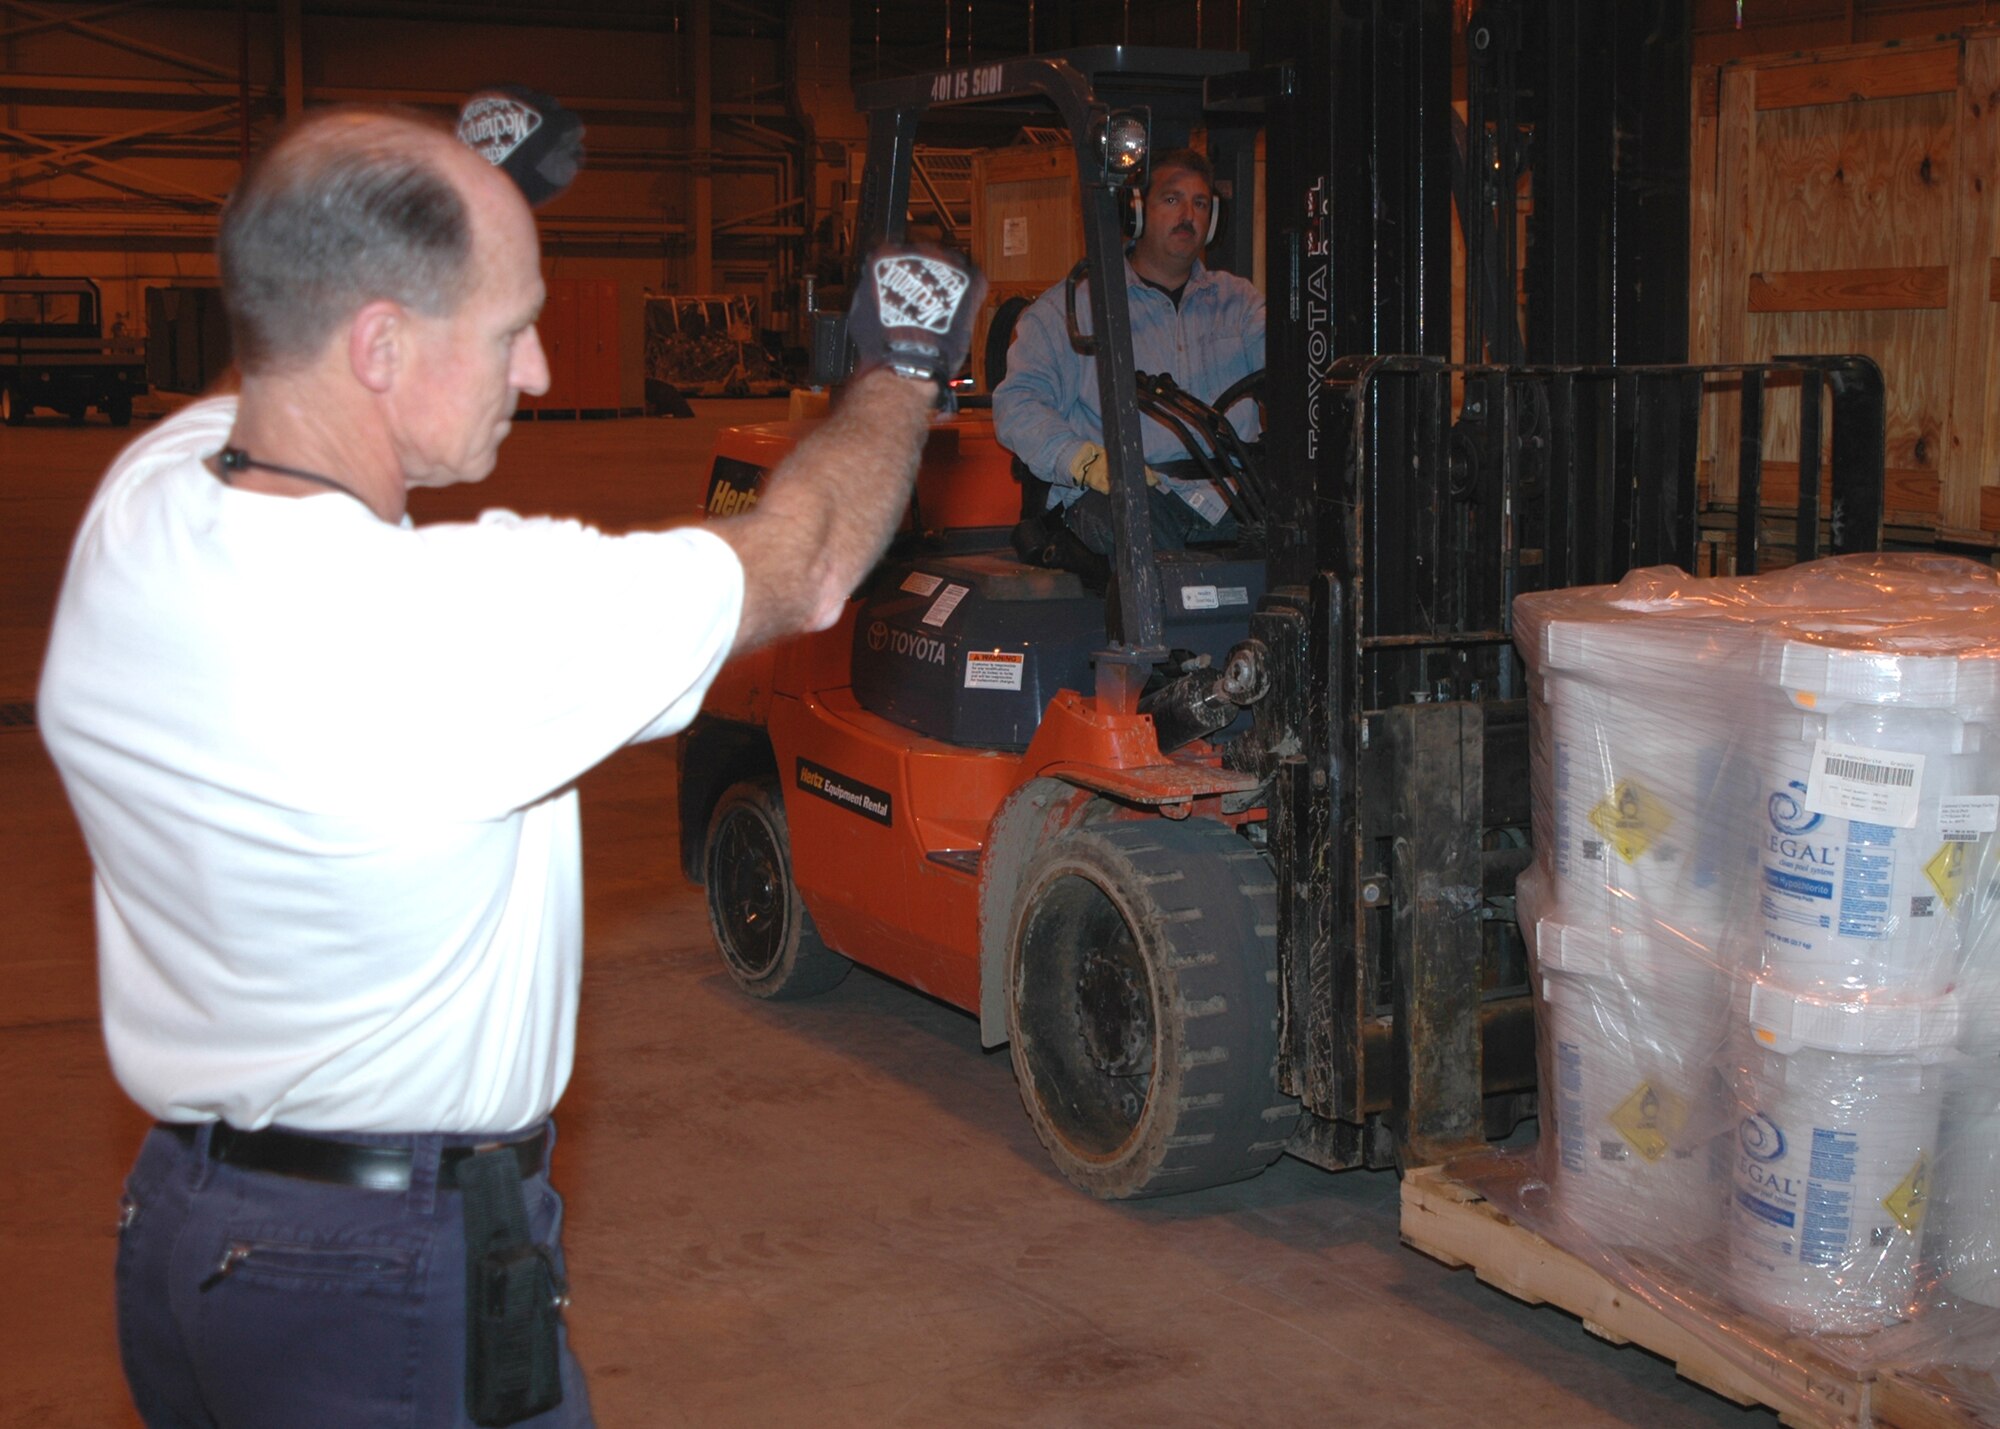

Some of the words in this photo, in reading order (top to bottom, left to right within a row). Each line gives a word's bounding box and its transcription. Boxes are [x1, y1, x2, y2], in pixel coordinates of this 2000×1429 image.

[931, 73, 951, 102] 401
[955, 71, 968, 99] 15
[1307, 264, 1328, 460] TOYOTA
[708, 480, 758, 517] Hert
[891, 629, 946, 666] TOYOTA
[800, 767, 824, 789] Hertz
[824, 779, 863, 807] Equipment
[863, 795, 888, 816] Rental
[1769, 835, 1835, 866] EGAL
[1794, 863, 1809, 872] pool
[1777, 875, 1829, 894] Hypochlorite
[1740, 1157, 1797, 1197] EGAL
